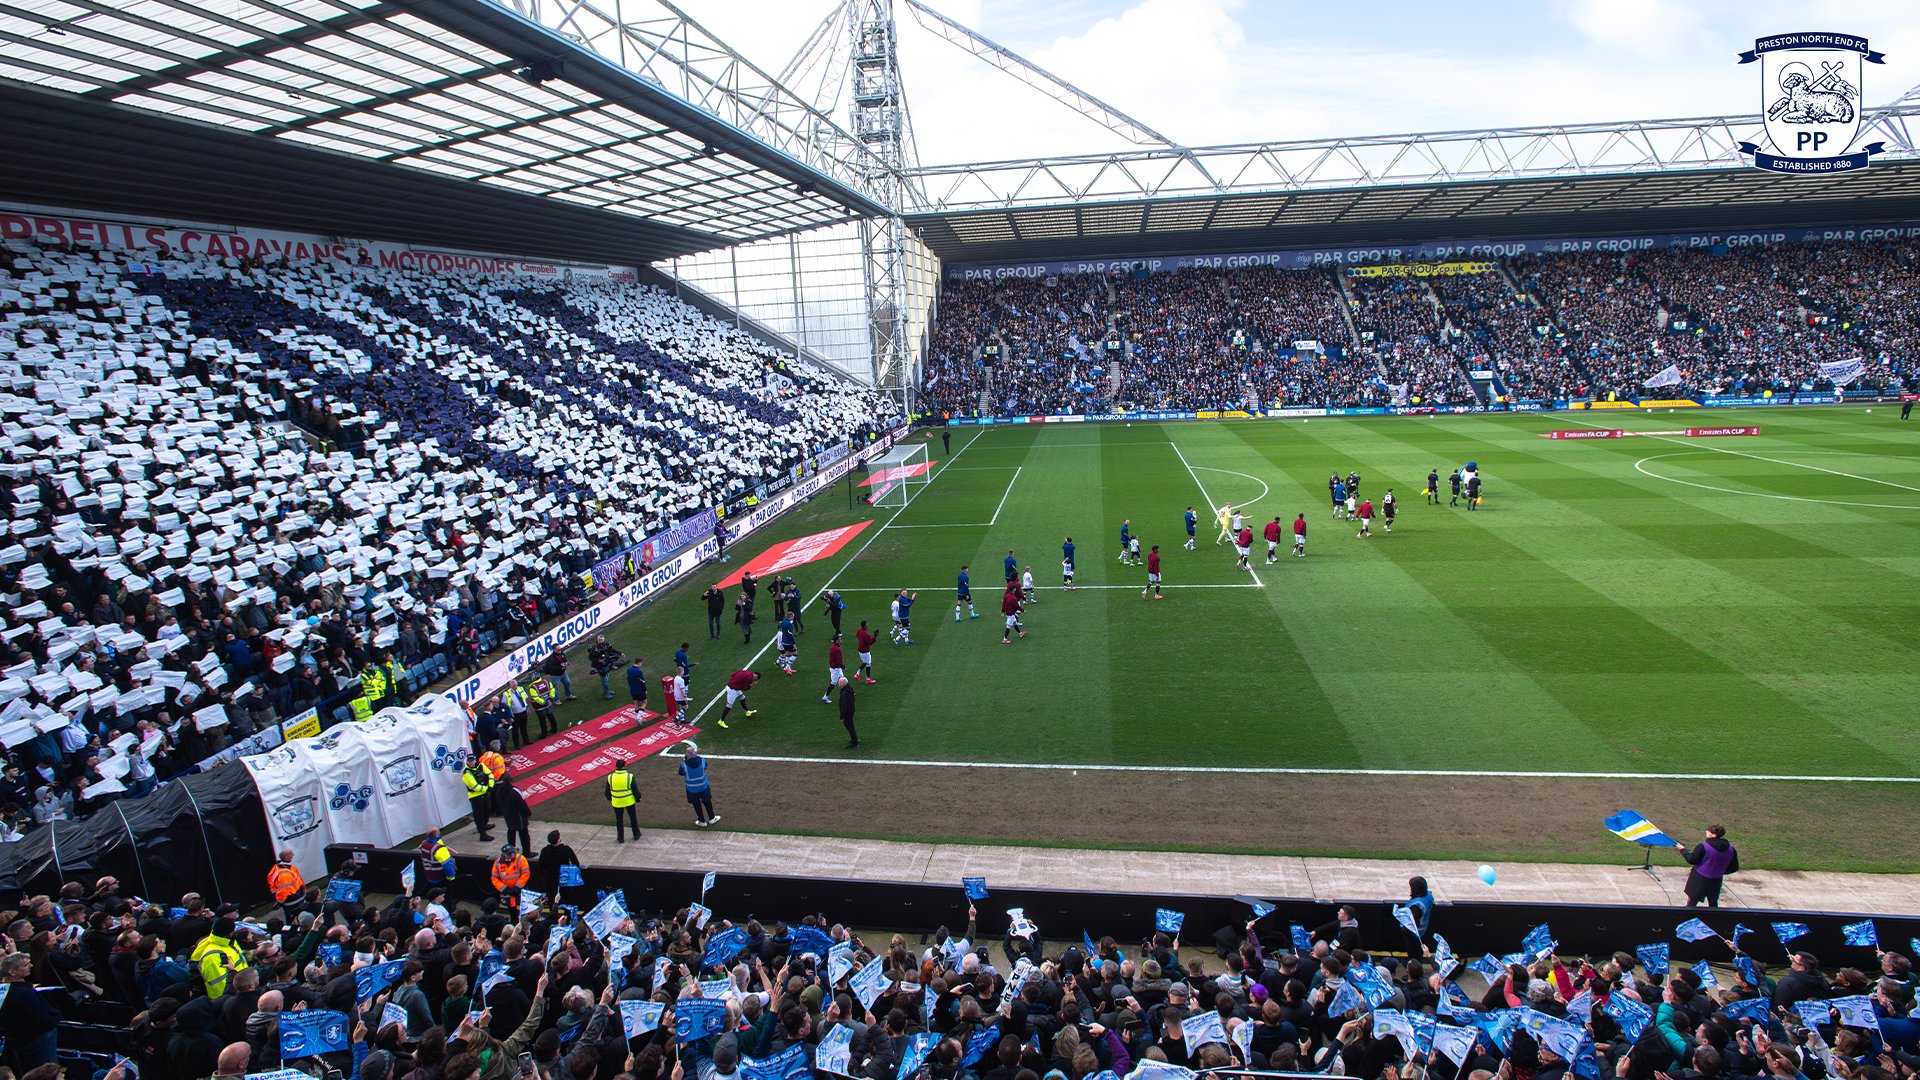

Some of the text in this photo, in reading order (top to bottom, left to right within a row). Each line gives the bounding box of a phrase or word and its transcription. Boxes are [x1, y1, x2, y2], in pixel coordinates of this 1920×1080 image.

[1823, 230, 1855, 241] PAR
[1561, 238, 1654, 253] PAR GROUP
[181, 231, 346, 262] CARAVANS
[379, 249, 516, 278] MOTORHOMES
[1194, 254, 1280, 268] PAR GROUP
[1314, 251, 1342, 264] PAR
[520, 263, 557, 275] Campbells
[965, 266, 1046, 281] PAR GROUP
[1078, 262, 1105, 274] PAR
[1381, 264, 1464, 276] PAR-GROUP.co.uk
[805, 478, 820, 495] GROUP
[755, 511, 767, 525] PAR
[766, 498, 785, 518] GROUP
[703, 540, 717, 558] PAR
[630, 578, 650, 602] PAR
[651, 559, 682, 590] GROUP
[526, 606, 601, 666] PAR GROUP
[287, 720, 317, 738] EMERGENCY
[303, 726, 316, 736] ONLY
